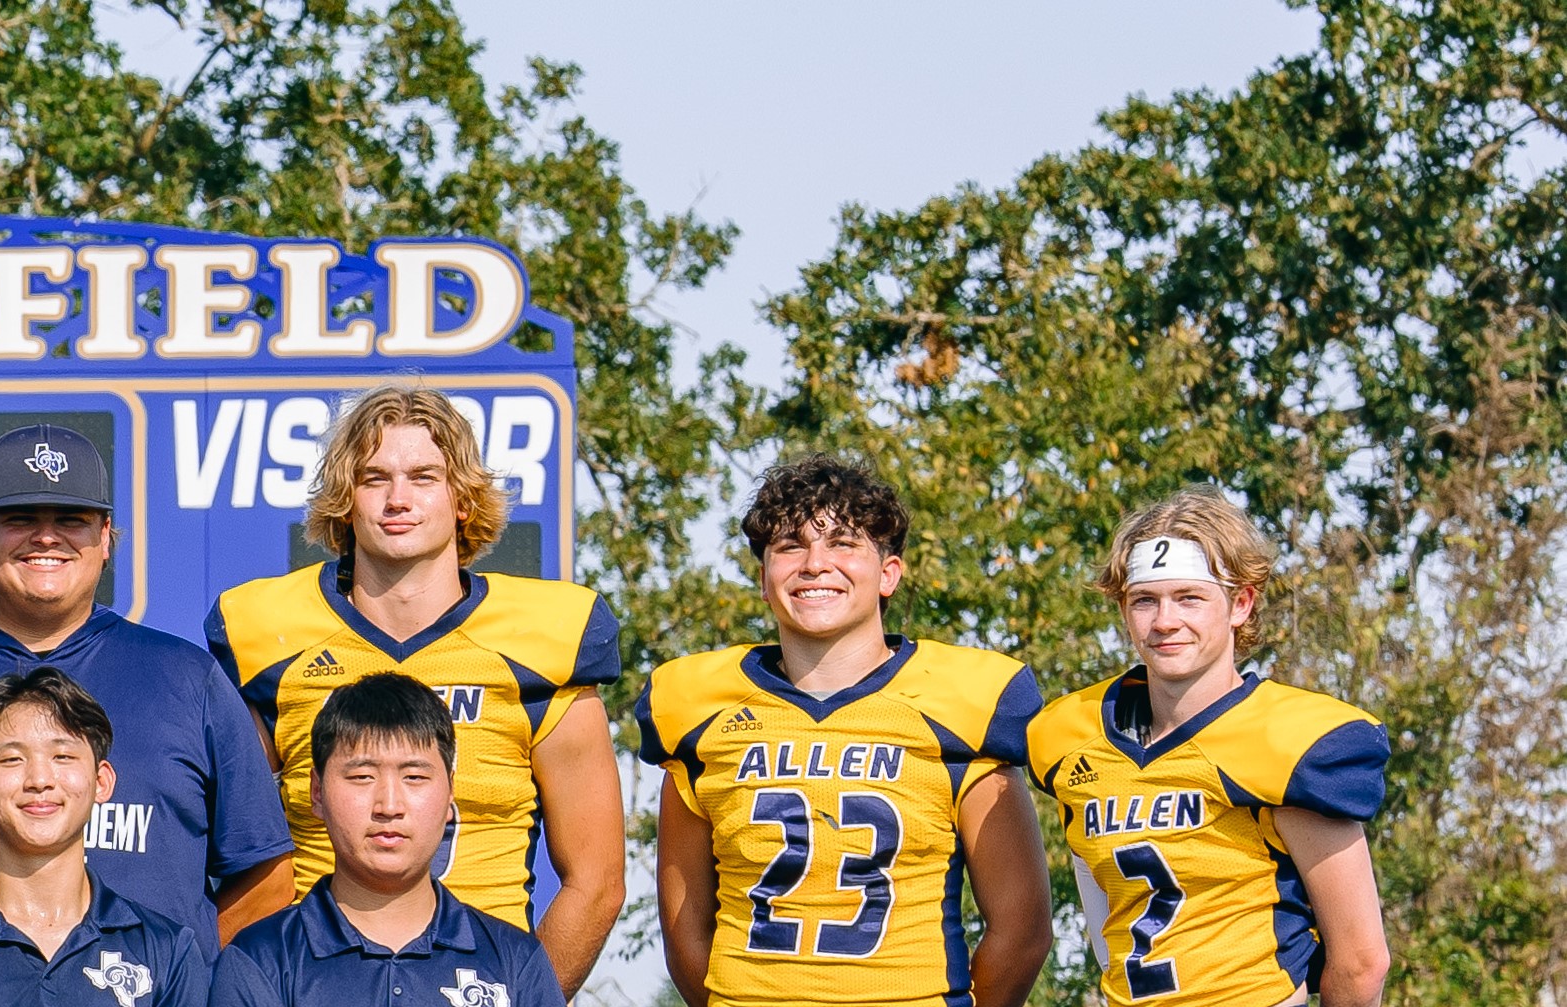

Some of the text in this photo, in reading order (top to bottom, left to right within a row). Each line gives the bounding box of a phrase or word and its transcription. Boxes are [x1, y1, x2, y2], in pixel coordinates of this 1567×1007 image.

[1152, 540, 1170, 570] 2
[303, 665, 345, 678] adidas
[721, 720, 763, 734] adidas
[734, 741, 906, 783] ALLEN
[1067, 772, 1099, 787] adidas
[1083, 790, 1205, 840] ALLEN
[746, 788, 906, 960] 23
[1113, 841, 1187, 1000] 2
